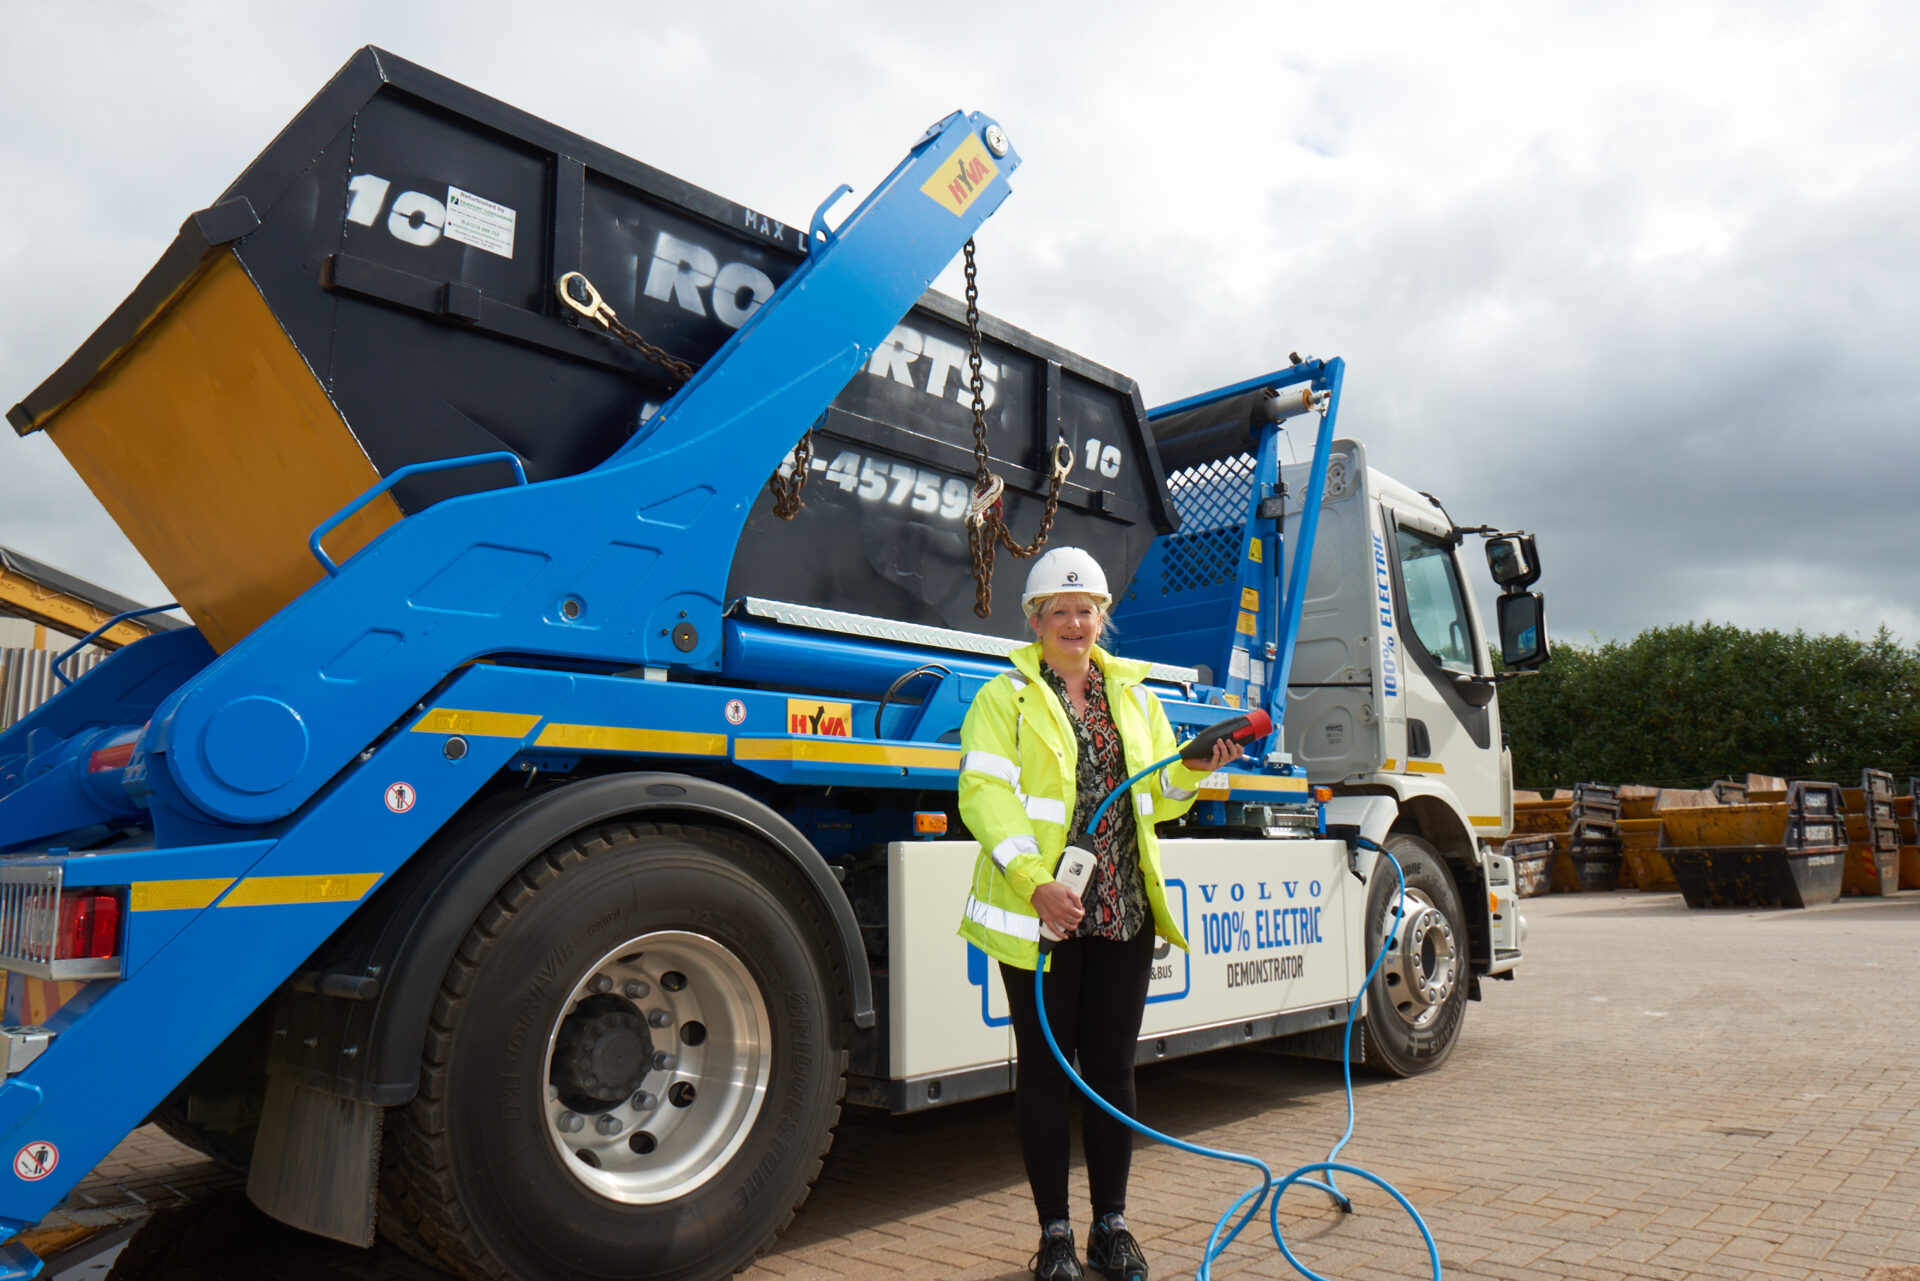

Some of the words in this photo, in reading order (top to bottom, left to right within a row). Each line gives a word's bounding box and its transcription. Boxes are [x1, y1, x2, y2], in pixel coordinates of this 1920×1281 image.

[948, 157, 990, 206] HYVA
[347, 173, 447, 247] 10
[745, 208, 785, 242] MAX
[1085, 438, 1122, 479] 10
[1372, 529, 1393, 629] ELECTRIC
[1382, 635, 1399, 698] 100%
[791, 705, 847, 736] HYVA
[1199, 880, 1322, 903] VOLVO
[1202, 911, 1251, 955] 100%
[1256, 906, 1323, 950] ELECTRIC
[1227, 954, 1304, 988] DEMONSTRATOR
[733, 990, 812, 1215] BRIDGESTONE
